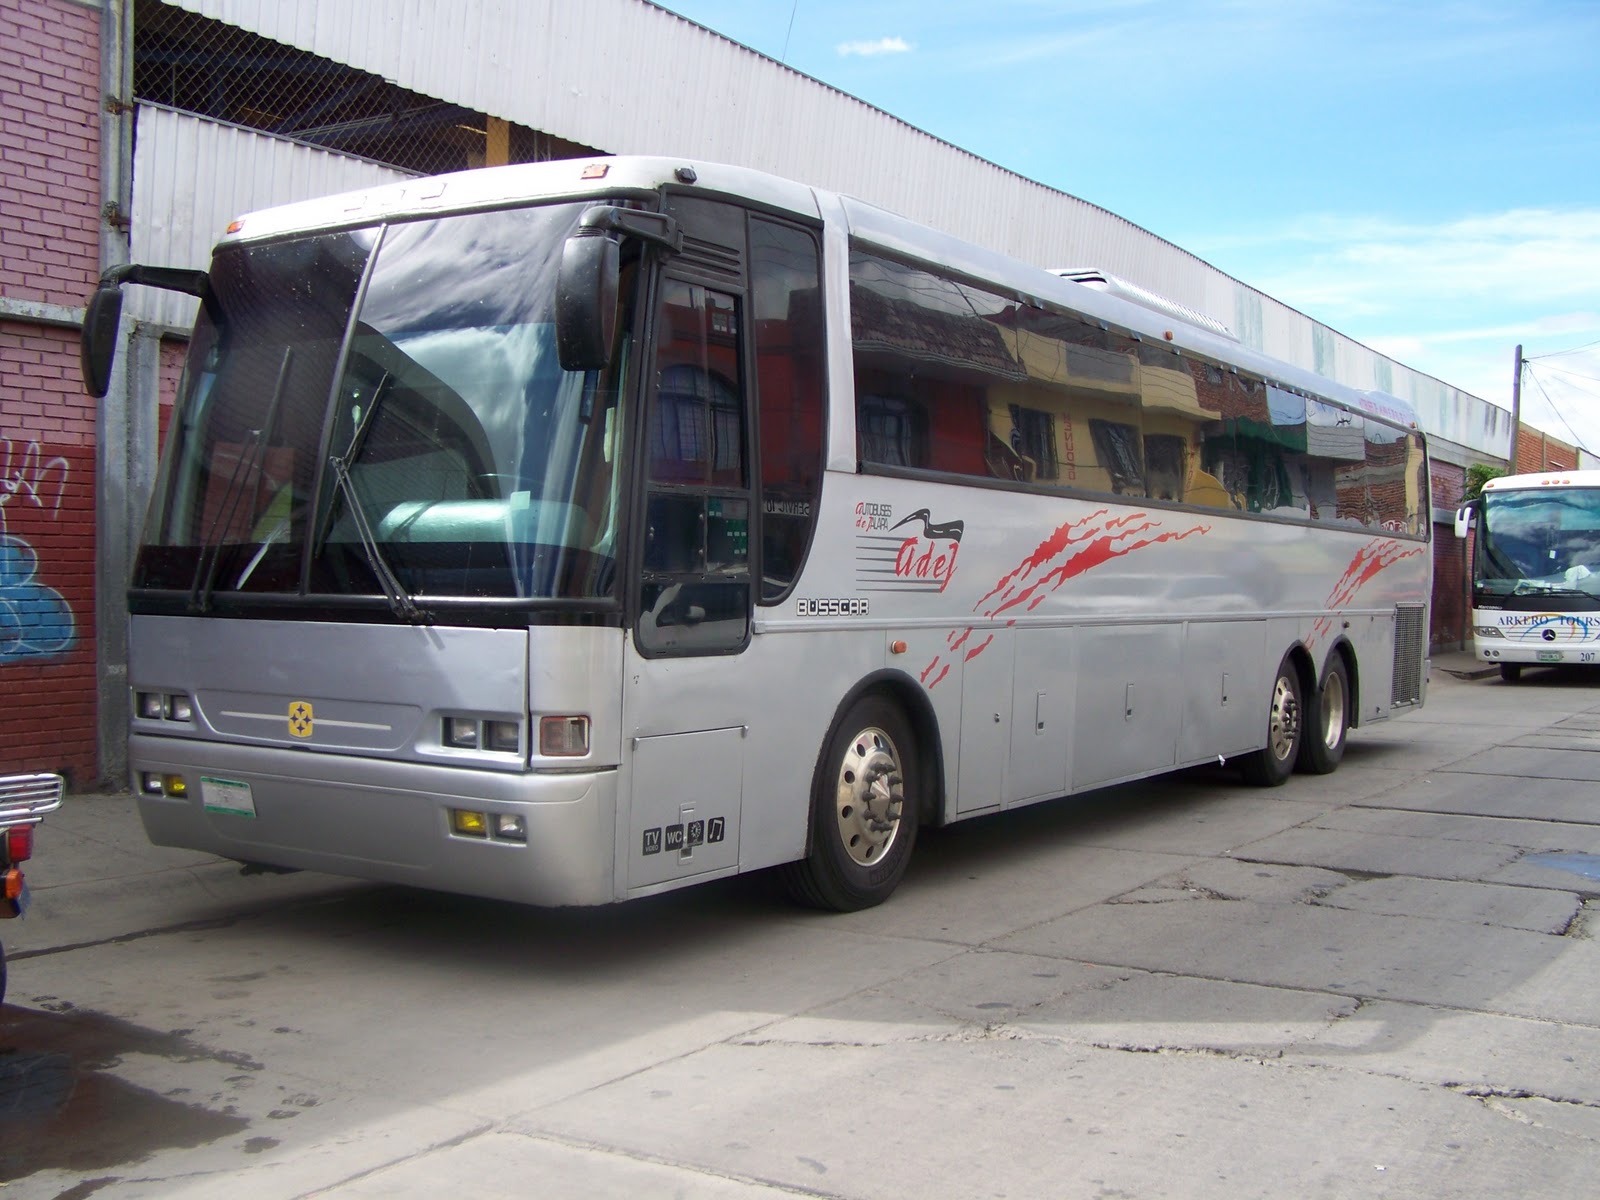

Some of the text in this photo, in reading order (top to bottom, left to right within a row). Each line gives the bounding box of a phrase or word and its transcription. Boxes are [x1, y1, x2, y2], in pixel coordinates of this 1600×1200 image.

[855, 516, 867, 529] de
[796, 598, 869, 617] BUSSCAR
[1497, 615, 1600, 627] ARKERO TOURS
[1580, 652, 1596, 662] 207
[645, 831, 660, 846] TV
[667, 831, 682, 845] WC
